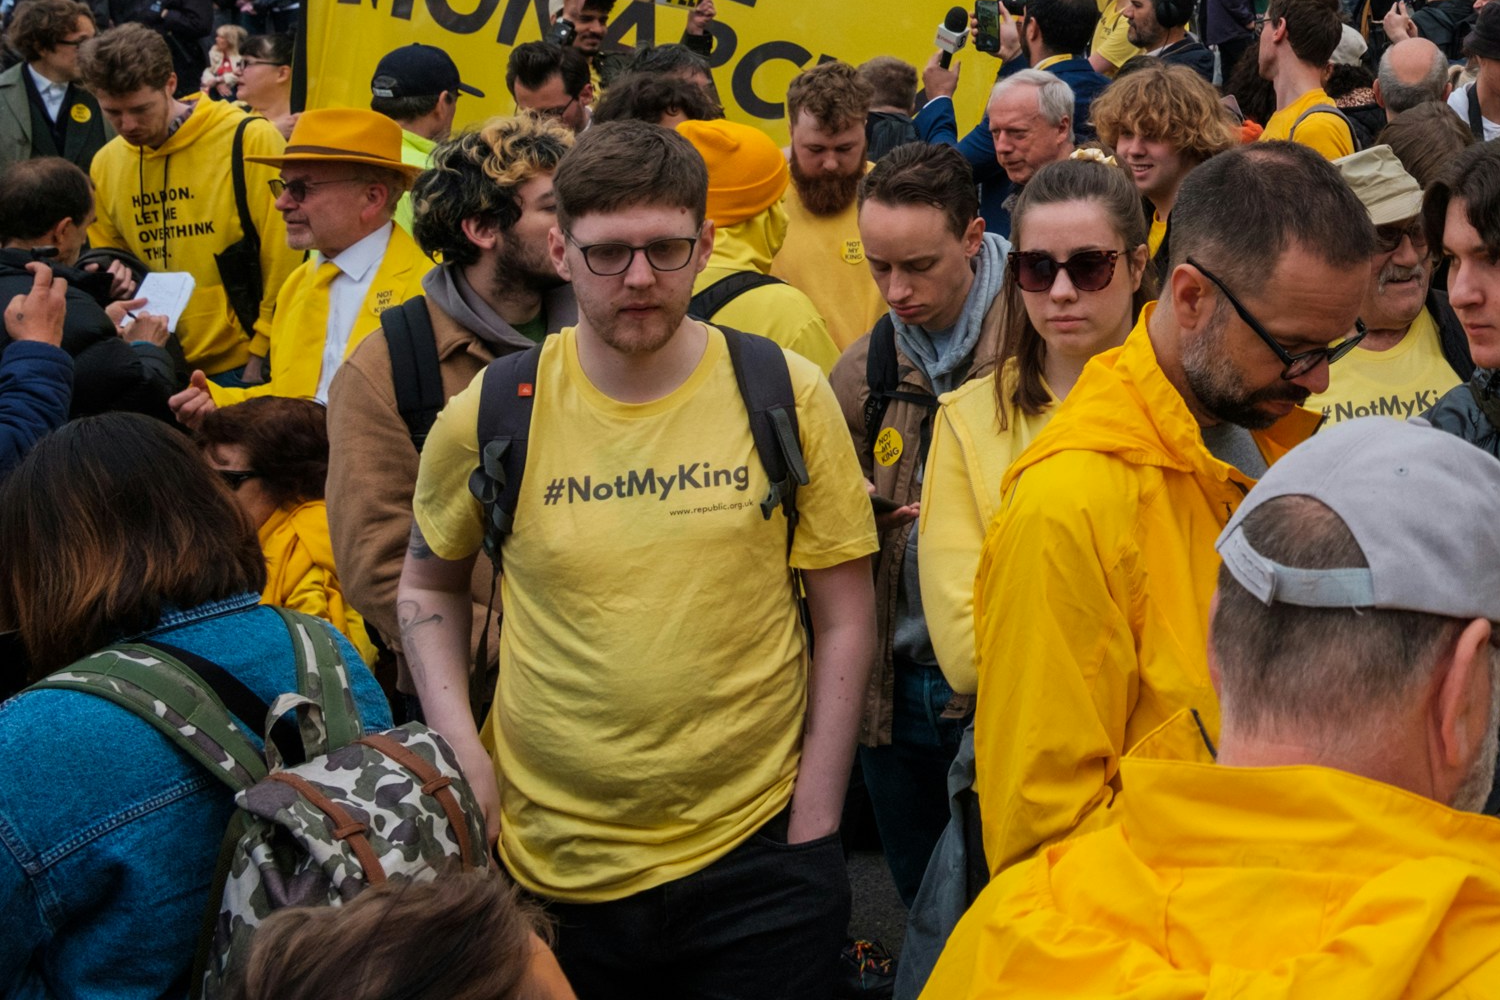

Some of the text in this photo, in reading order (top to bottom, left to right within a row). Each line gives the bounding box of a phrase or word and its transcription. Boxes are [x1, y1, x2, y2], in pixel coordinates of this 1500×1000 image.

[132, 187, 194, 208] HOLD ON.
[134, 210, 159, 226] LET
[139, 221, 215, 243] OVERTHINK
[376, 289, 393, 299] NOT
[1321, 389, 1440, 424] #NotMyKi
[878, 430, 891, 446] NOT
[881, 441, 891, 453] MY
[882, 447, 899, 464] KING
[544, 462, 749, 505] #NotMyKing
[669, 498, 754, 516] www.republic.org.uk
